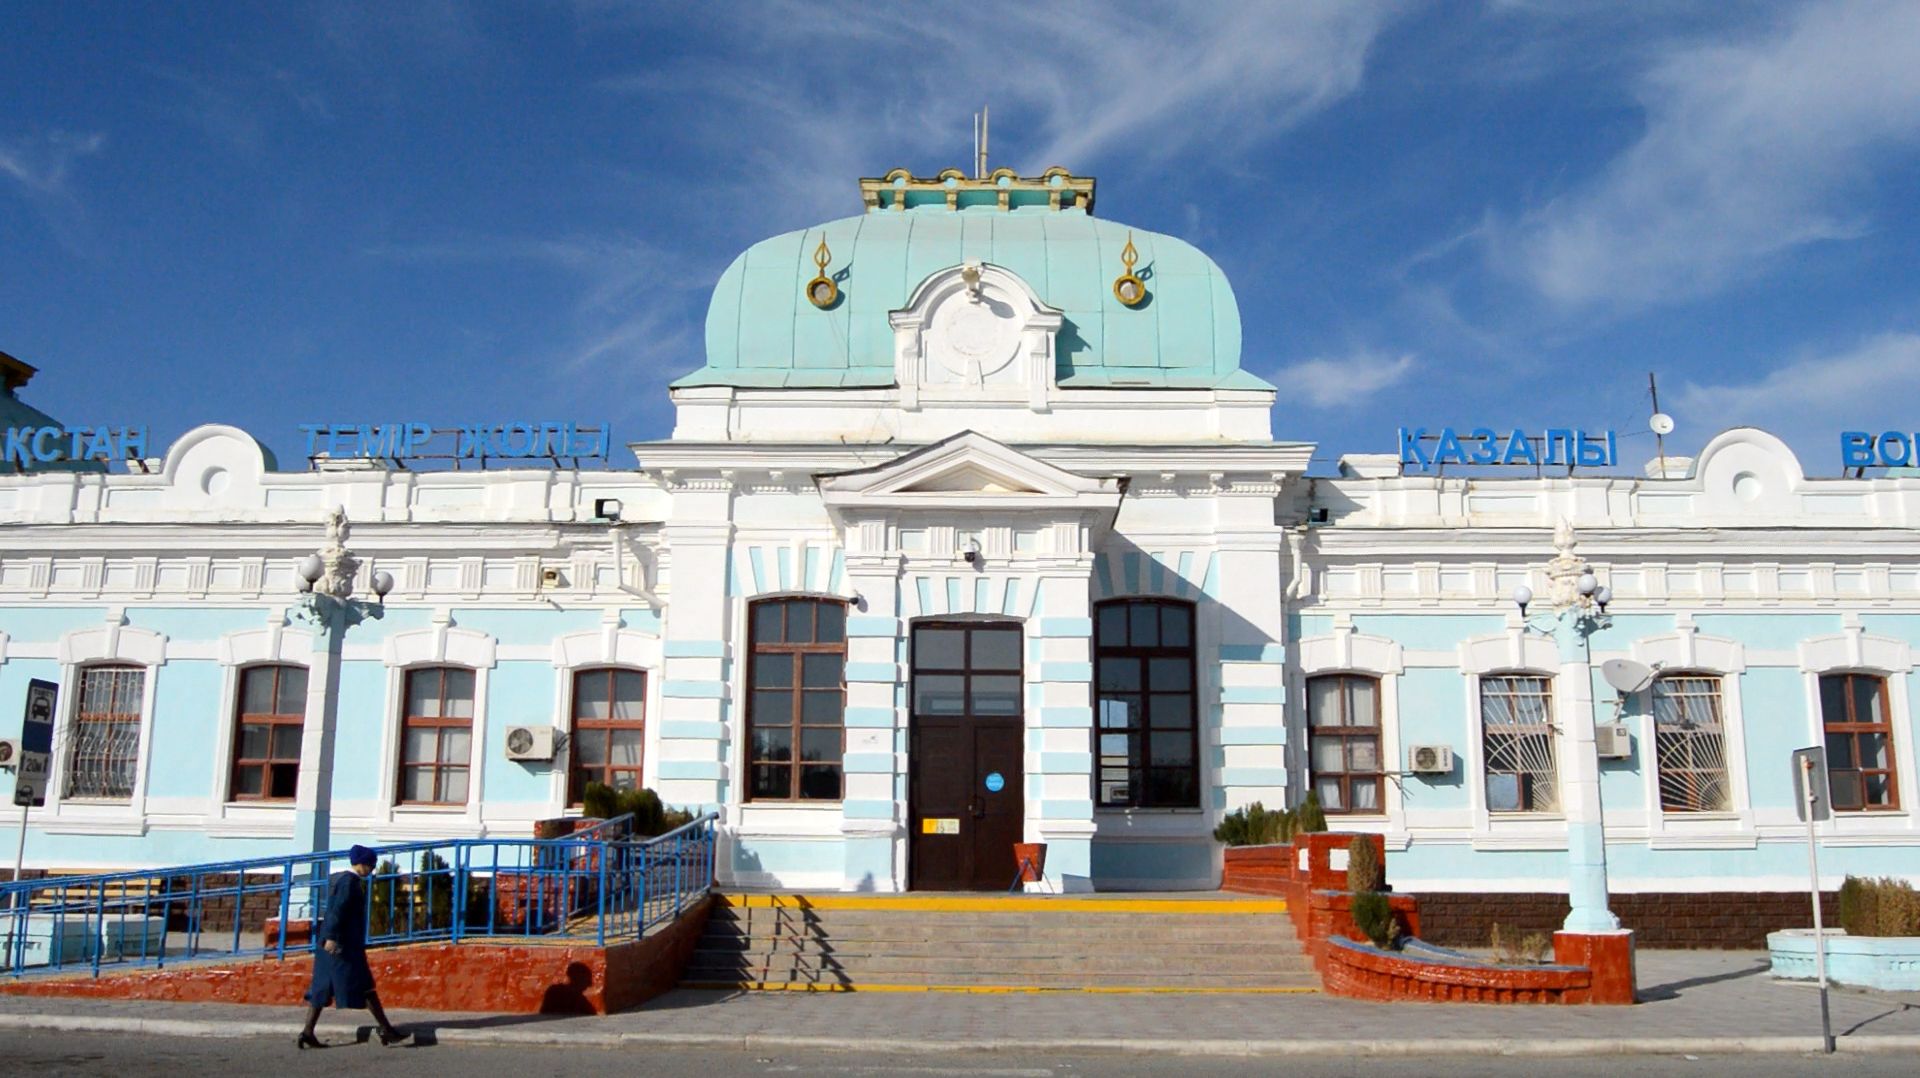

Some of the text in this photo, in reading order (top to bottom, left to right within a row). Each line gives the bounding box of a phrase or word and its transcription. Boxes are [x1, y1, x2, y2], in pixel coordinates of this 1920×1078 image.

[0, 420, 611, 468] ҚСТАН ТЕМІР ЖОЛЫ
[1398, 427, 1618, 471] ҚАЗАЛЫ
